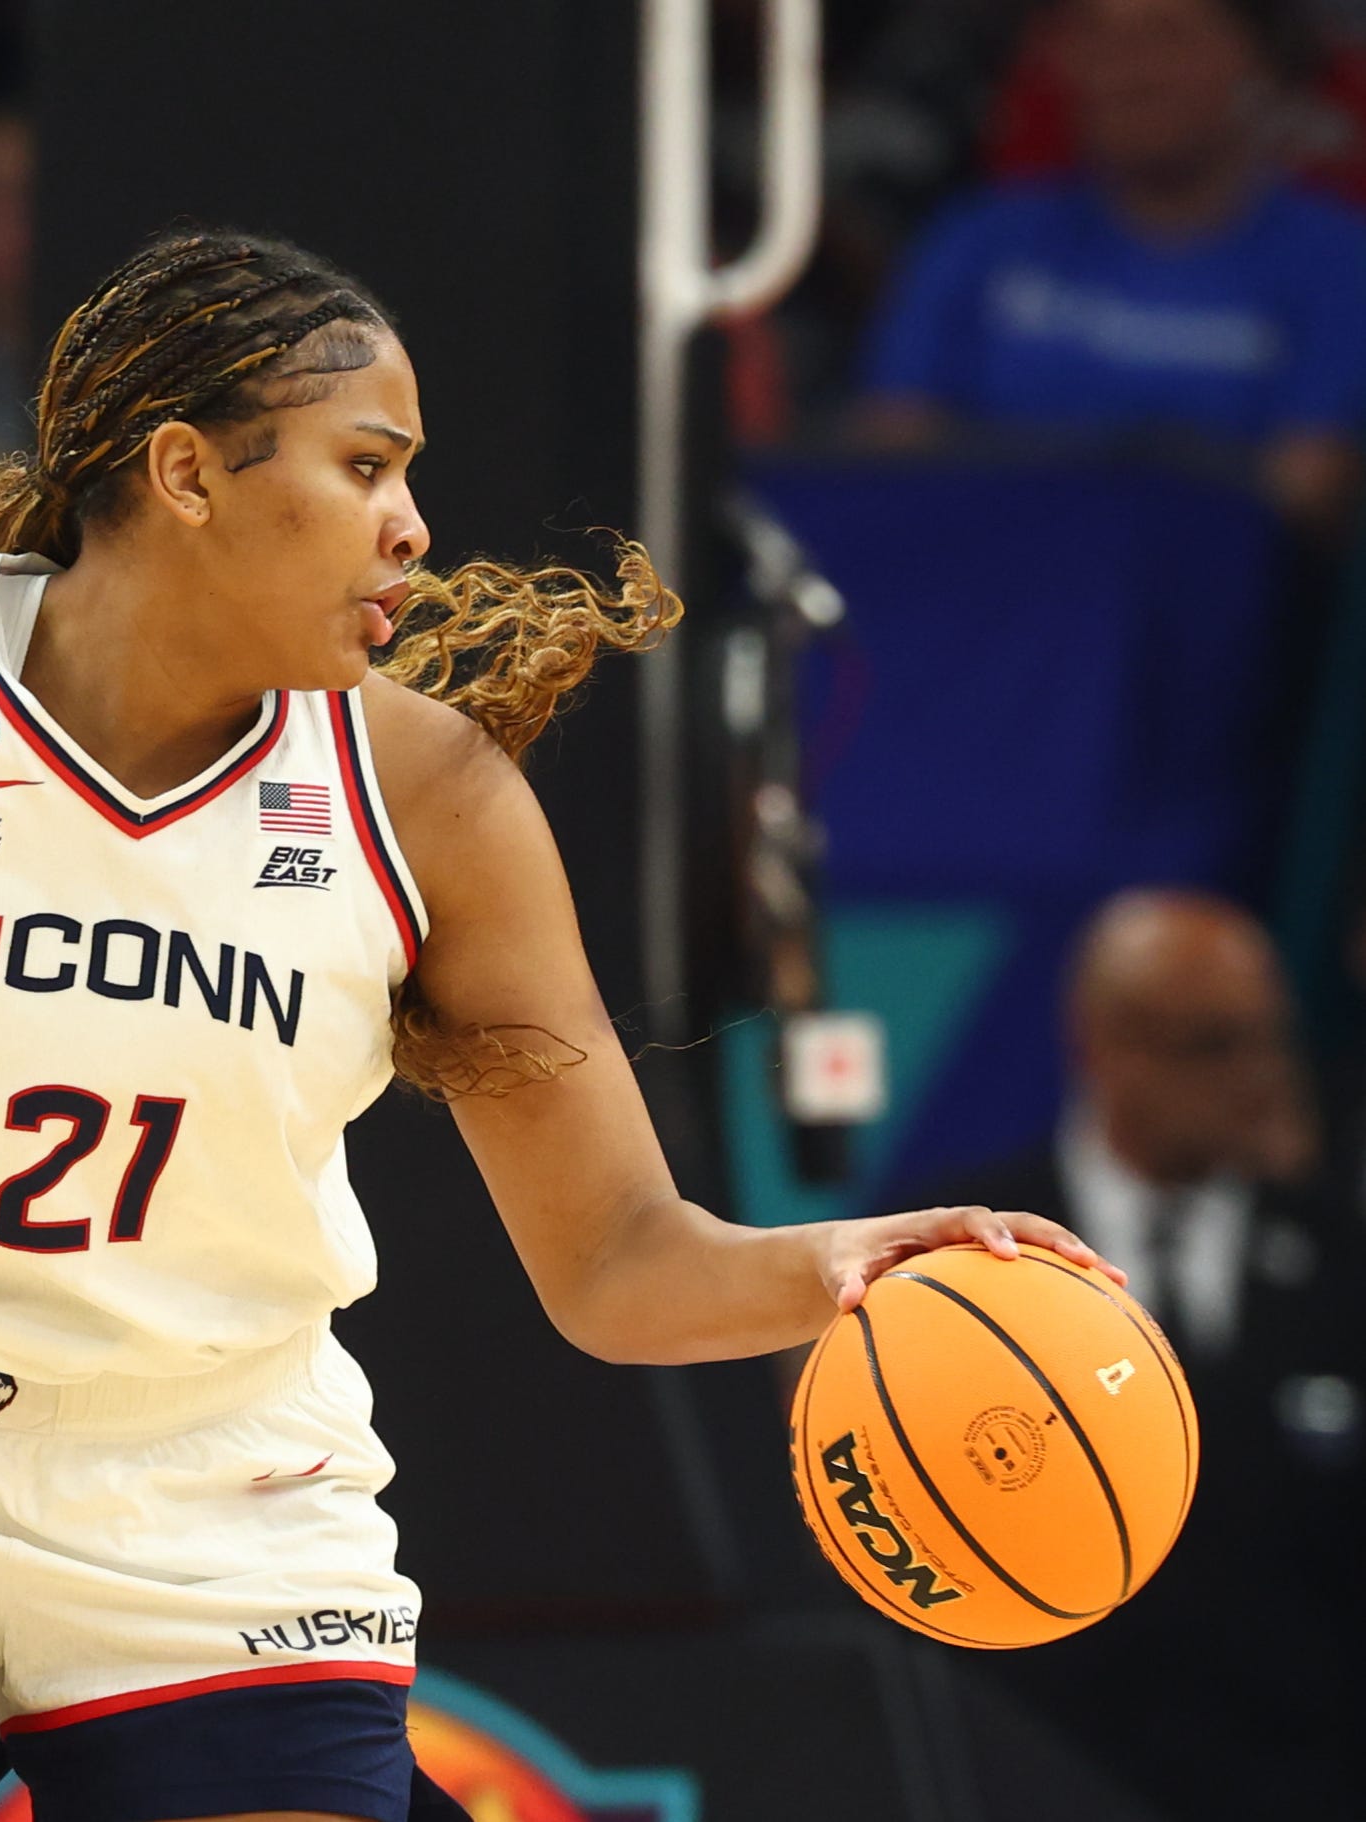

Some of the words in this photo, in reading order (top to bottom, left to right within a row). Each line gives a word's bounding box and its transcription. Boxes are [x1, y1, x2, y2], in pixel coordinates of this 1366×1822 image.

[259, 863, 338, 883] EAST
[268, 846, 323, 865] BIG
[860, 1424, 880, 1476] BALL
[820, 1430, 965, 1609] NCAA
[238, 1605, 416, 1655] HUSKIES
